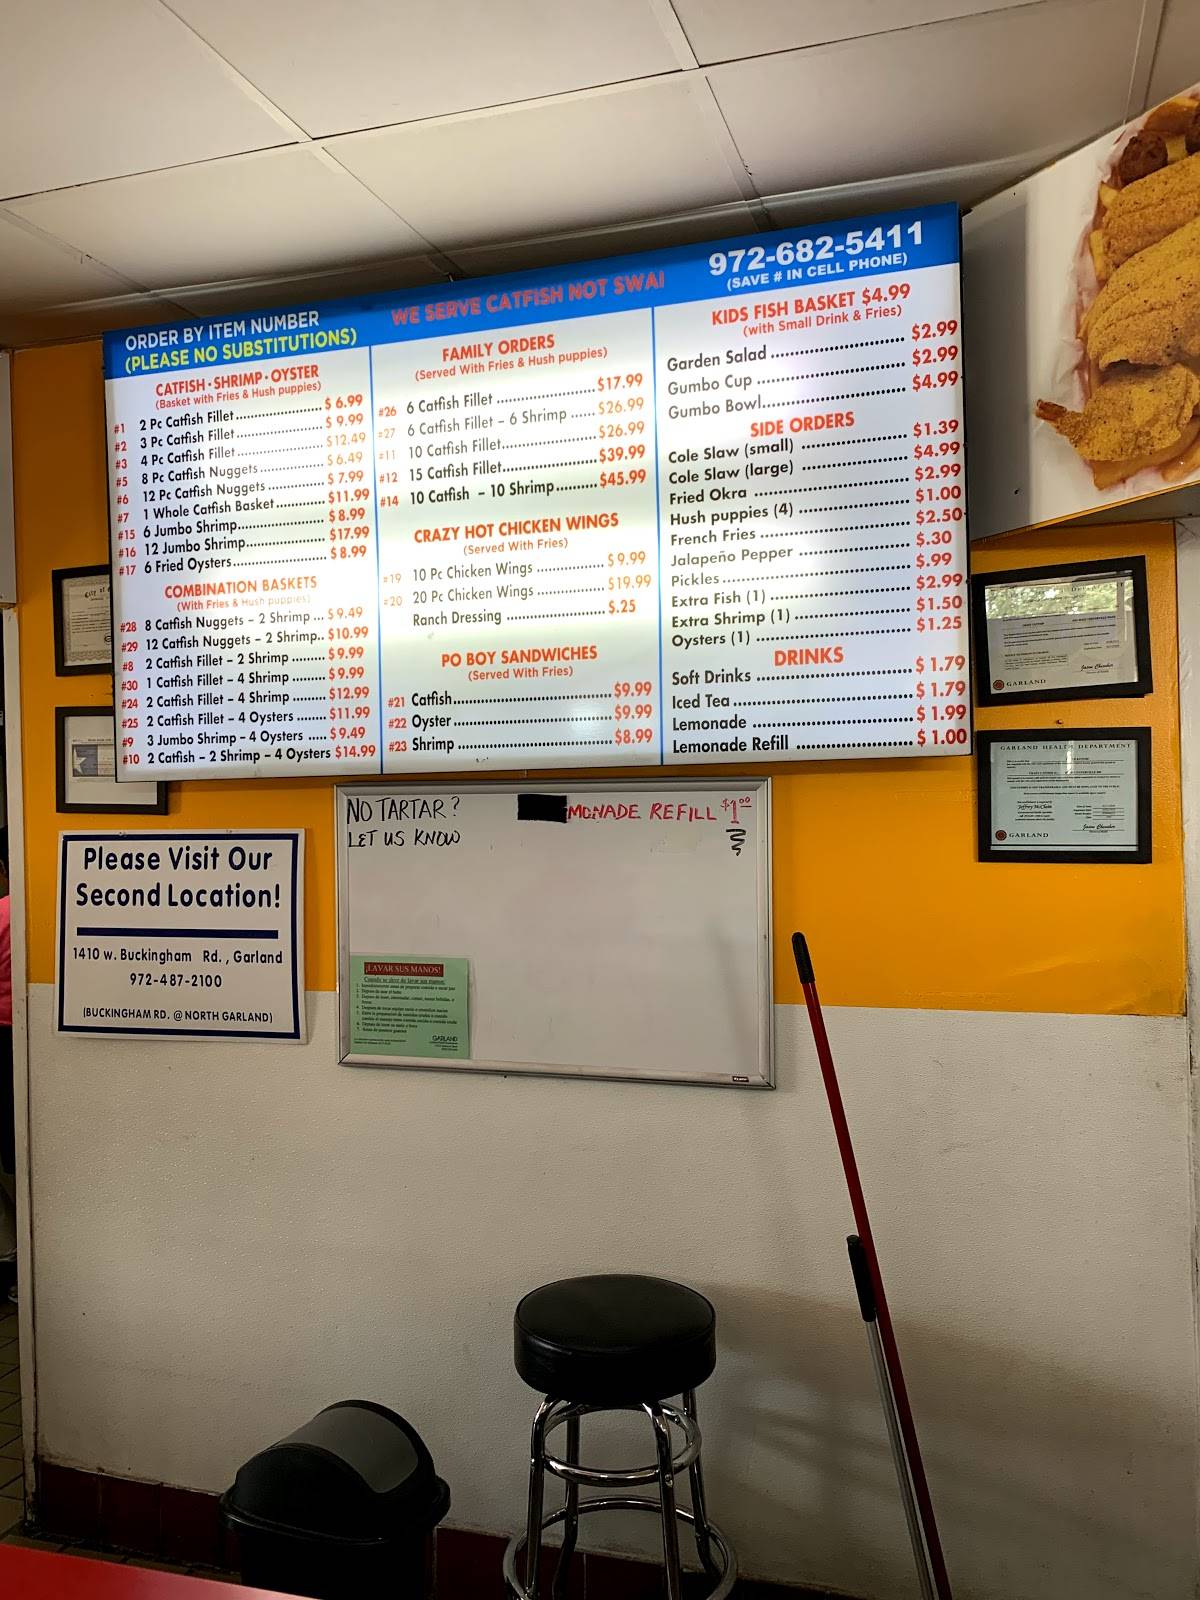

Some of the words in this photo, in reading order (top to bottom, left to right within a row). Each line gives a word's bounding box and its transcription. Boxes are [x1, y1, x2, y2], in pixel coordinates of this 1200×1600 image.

[709, 221, 924, 277] 972-682-5411
[727, 273, 769, 291] (SAVE
[787, 268, 802, 280] IN
[807, 262, 844, 277] CELL
[849, 252, 907, 271] PHONE)
[393, 307, 420, 324] WE
[424, 298, 482, 323] SERVE
[485, 285, 564, 314] CATFISH
[569, 279, 606, 300] NOT
[614, 272, 664, 294] SWAI
[712, 307, 748, 325] KIDS
[754, 301, 788, 319] FISH
[795, 292, 855, 314] BASKET
[862, 284, 910, 306] $4.99
[126, 330, 179, 352] ORDER
[184, 326, 203, 343] BY
[209, 320, 246, 340] ITEM
[250, 311, 320, 335] NUMBER
[744, 322, 774, 337] (with
[779, 316, 811, 331] Small
[816, 312, 848, 326] Drink
[866, 304, 902, 319] Fries)
[126, 349, 189, 374] (PLEASE
[194, 346, 217, 363] NO
[223, 325, 359, 361] SUBSTITUTIONS)
[443, 342, 493, 362] FAMILY
[498, 334, 554, 354] ORDERS
[668, 353, 720, 371] Garden
[726, 344, 766, 364] Salad
[912, 320, 958, 342] $2.99
[415, 366, 456, 381] (Served
[460, 362, 484, 374] With
[488, 360, 514, 371] Fries
[528, 353, 554, 366] Hush
[559, 346, 607, 364] puppies)
[668, 377, 719, 395] Gumbo
[725, 374, 752, 390] Cup
[913, 345, 958, 366] $2.99
[156, 397, 190, 410] (Basket
[194, 394, 213, 404] with
[217, 392, 239, 402] Fries
[252, 386, 275, 398] Hush
[278, 380, 321, 396] puppies)
[419, 395, 459, 412] Catfish
[464, 392, 492, 407] Fillet
[598, 373, 642, 392] $17.99
[669, 401, 720, 419] Gumbo
[726, 394, 761, 412] Bowl
[913, 370, 959, 392] $4.99
[751, 420, 783, 437] SIDE
[790, 412, 854, 432] ORDERS
[669, 449, 698, 463] Cole
[704, 446, 739, 460] Slaw
[745, 438, 793, 458] (small)
[914, 419, 959, 438] $1.39
[429, 486, 469, 503] Catfish
[510, 480, 554, 496] Shrimp
[600, 469, 646, 488] $45.99
[670, 489, 704, 504] Fried
[710, 487, 746, 501] Okra
[153, 505, 189, 519] Whole
[193, 501, 231, 515] Catfish
[236, 498, 274, 511] Basket
[328, 488, 369, 504] $11.99
[671, 510, 705, 525] Hush
[712, 506, 768, 525] puppies
[916, 486, 962, 504] $1.00
[330, 526, 369, 542] $17.99
[414, 526, 460, 543] CRAZY
[465, 524, 494, 539] HOT
[499, 518, 560, 536] CHICKEN
[566, 512, 618, 530] WINGS
[671, 530, 716, 546] French
[723, 528, 755, 541] Fries
[916, 507, 963, 526] $2.50
[464, 542, 504, 556] (Served
[508, 540, 533, 551] With
[538, 538, 568, 549] Fries)
[671, 551, 736, 568] Jalapeño
[742, 548, 793, 563] Pepper
[916, 530, 952, 548] $.30
[447, 564, 491, 579] Chicken
[496, 561, 532, 577] Wings
[672, 572, 719, 587] Pickles
[916, 552, 952, 569] $.99
[164, 581, 256, 598] COMBINATION
[262, 576, 316, 591] BASKETS
[672, 596, 708, 607] Extra
[714, 590, 740, 604] Fish
[917, 573, 964, 591] $2.99
[414, 611, 447, 626] Ranch
[452, 609, 501, 625] Dressing
[609, 600, 636, 614] $.25
[672, 635, 726, 650] Oysters
[917, 616, 962, 632] $1.25
[442, 653, 461, 667] PO
[467, 652, 496, 666] BOY
[502, 646, 597, 664] SANDWICHES
[775, 647, 843, 666] DRINKS
[468, 668, 509, 682] (Served
[513, 667, 538, 678] With
[542, 666, 573, 677] Fries)
[672, 670, 700, 685] Soft
[705, 668, 751, 683] Drinks
[412, 690, 451, 706] Catfish
[673, 693, 700, 709] Iced
[705, 694, 729, 707] Tea
[412, 714, 451, 732] Oyster
[673, 714, 746, 730] Lemonade
[158, 750, 194, 763] Catfish
[221, 749, 260, 764] Shrimp
[286, 748, 330, 762] Oysters
[336, 745, 376, 759] $14.99
[413, 736, 454, 754] Shrimp
[673, 737, 746, 753] Lemonade
[753, 735, 788, 750] Refill
[347, 798, 372, 824] NO
[650, 803, 717, 822] REFILL
[348, 830, 378, 847] LET
[384, 831, 404, 846] US
[414, 828, 460, 846] KNOW
[84, 846, 160, 870] Please
[169, 846, 219, 870] Visit
[229, 846, 272, 870] Our
[76, 882, 160, 906] Second
[168, 883, 279, 908] Location!
[74, 948, 99, 960] 1410
[121, 948, 191, 964] Buckingham
[234, 950, 282, 963] Garland
[130, 973, 222, 987] 972-487-2100
[84, 1008, 151, 1018] (BUCKINGHAM
[154, 1010, 169, 1019] RD.
[185, 1011, 219, 1020] NORTH
[222, 1012, 272, 1023] GARLAND)
